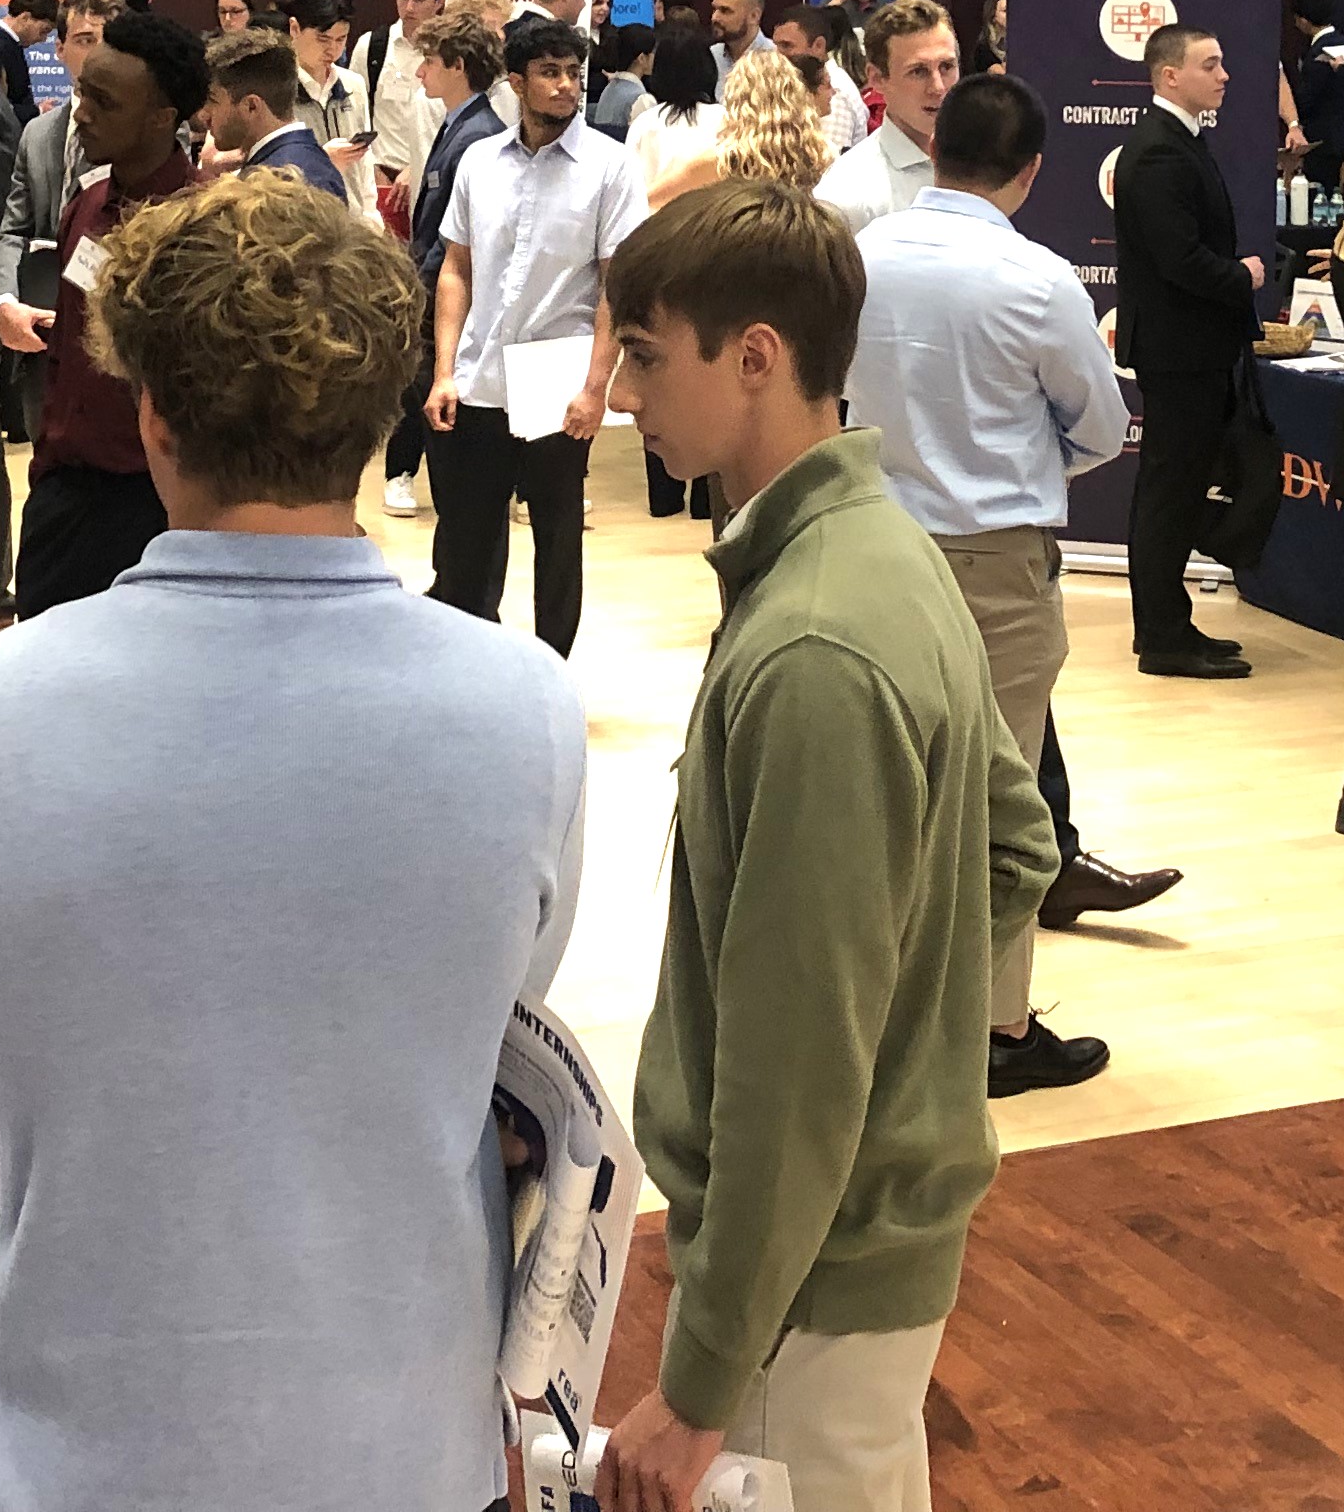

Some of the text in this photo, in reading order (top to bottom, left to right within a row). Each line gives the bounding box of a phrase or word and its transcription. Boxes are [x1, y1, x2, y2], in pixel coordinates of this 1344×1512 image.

[28, 51, 51, 61] The
[1062, 105, 1139, 125] CONTRACT
[513, 999, 603, 1128] INTERNSHIPS
